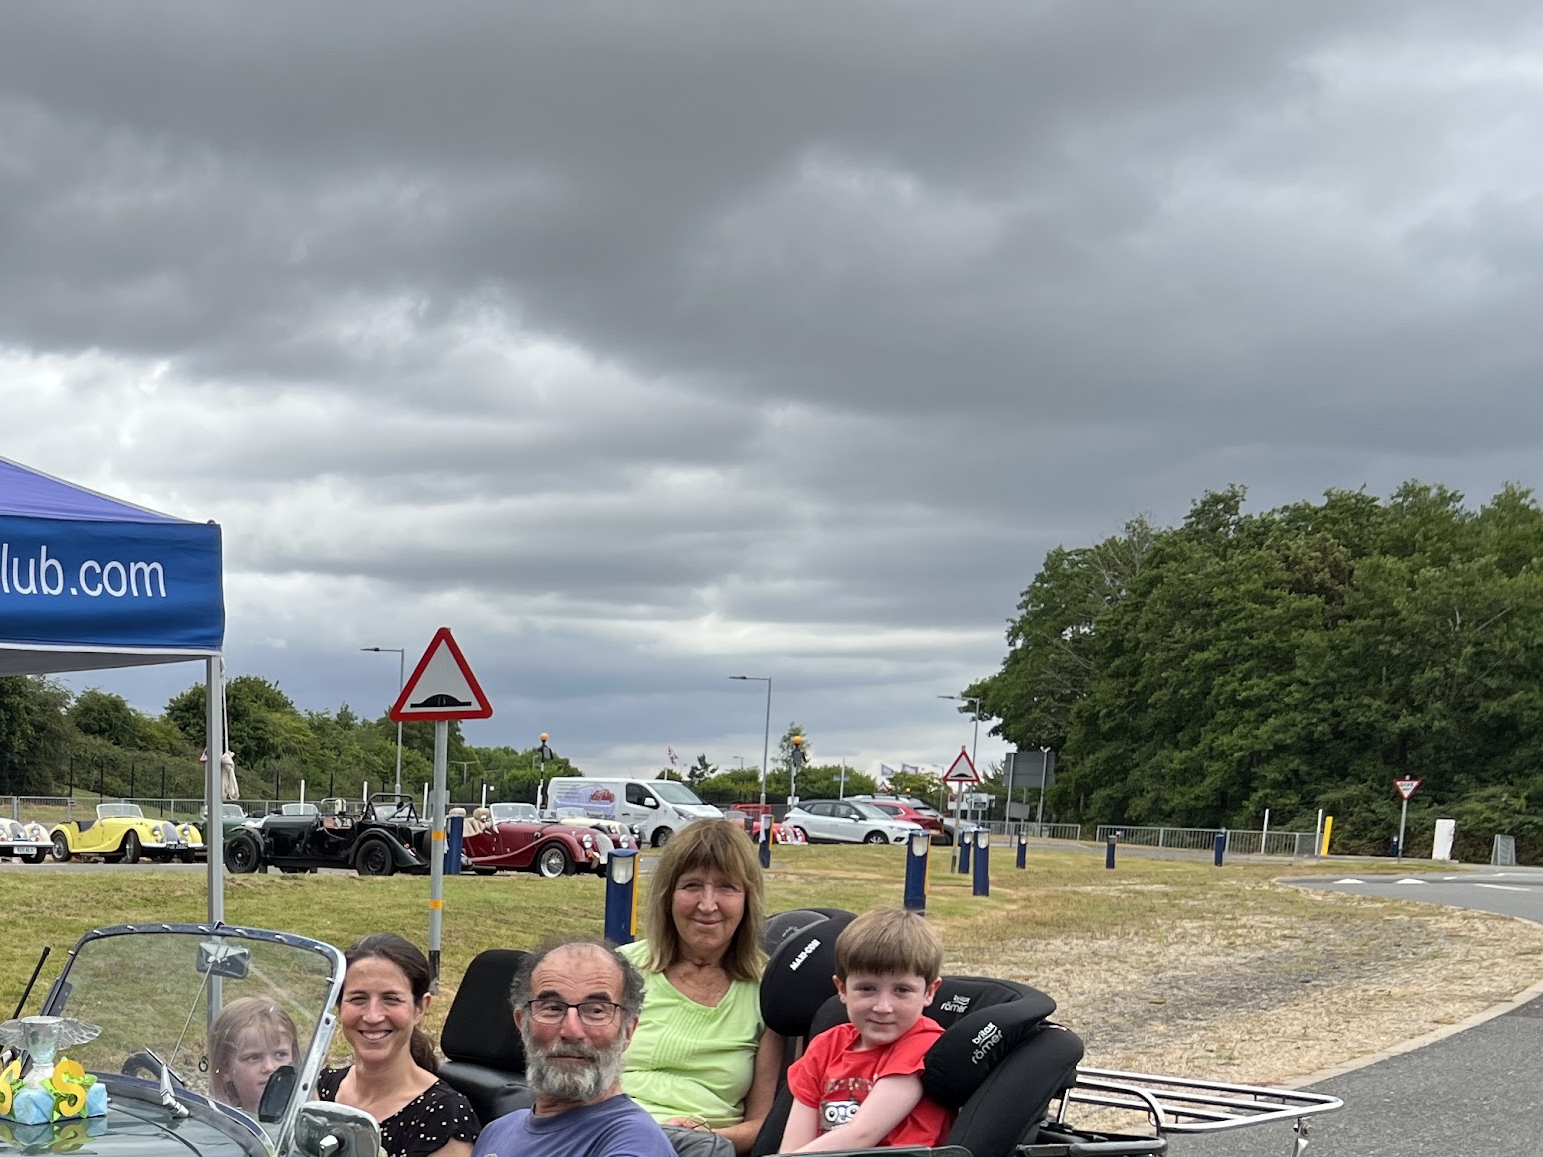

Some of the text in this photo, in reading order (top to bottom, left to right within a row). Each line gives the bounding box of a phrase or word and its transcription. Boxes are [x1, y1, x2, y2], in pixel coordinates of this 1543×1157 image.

[940, 1000, 968, 1013] römer
[971, 1021, 997, 1045] britax
[971, 1029, 1004, 1065] römer
[52, 1059, 87, 1118] S
